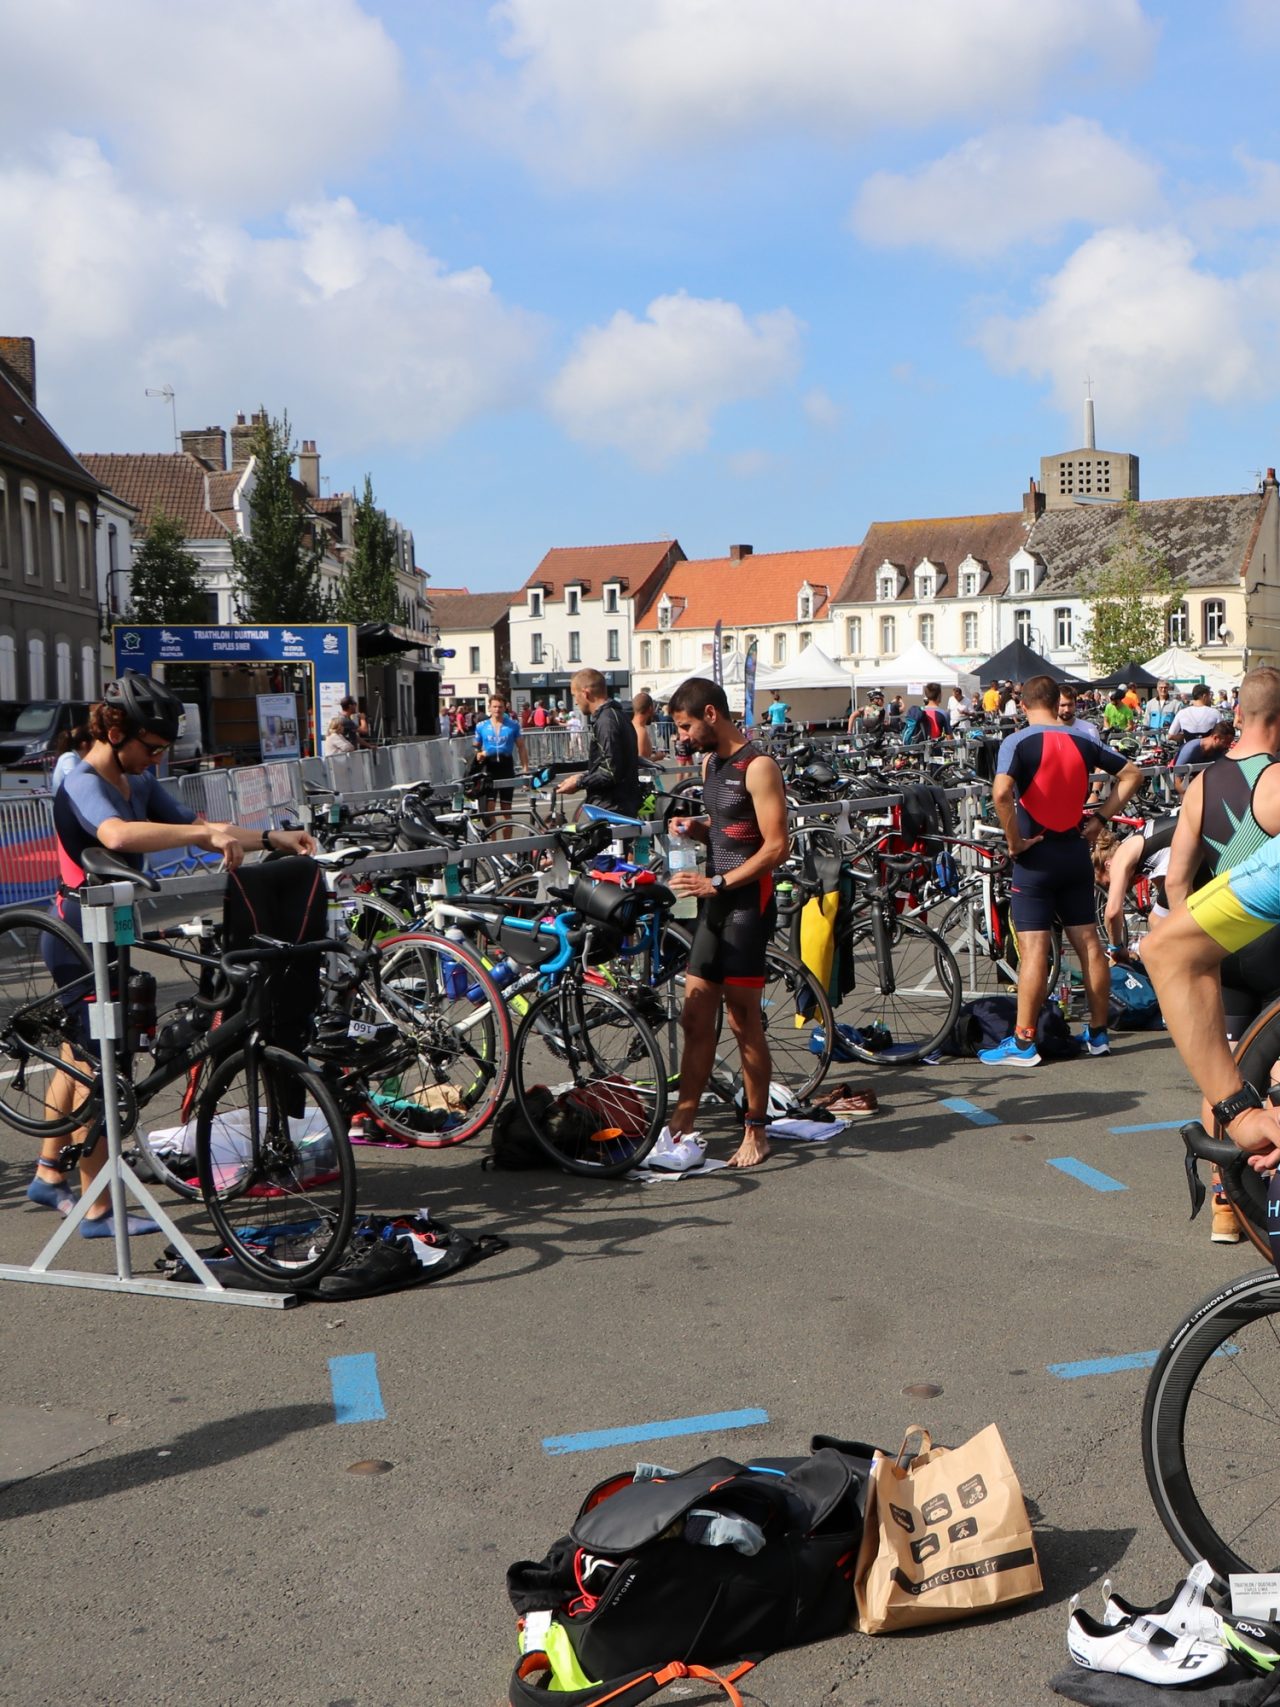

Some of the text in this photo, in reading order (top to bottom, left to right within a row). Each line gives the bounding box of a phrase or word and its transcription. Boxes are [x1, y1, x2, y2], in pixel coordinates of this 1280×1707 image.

[193, 630, 231, 640] TRIATHLON
[234, 630, 269, 640] DUATHLON
[612, 1574, 636, 1606] APTONIA
[911, 1559, 999, 1594] carrefour.fr
